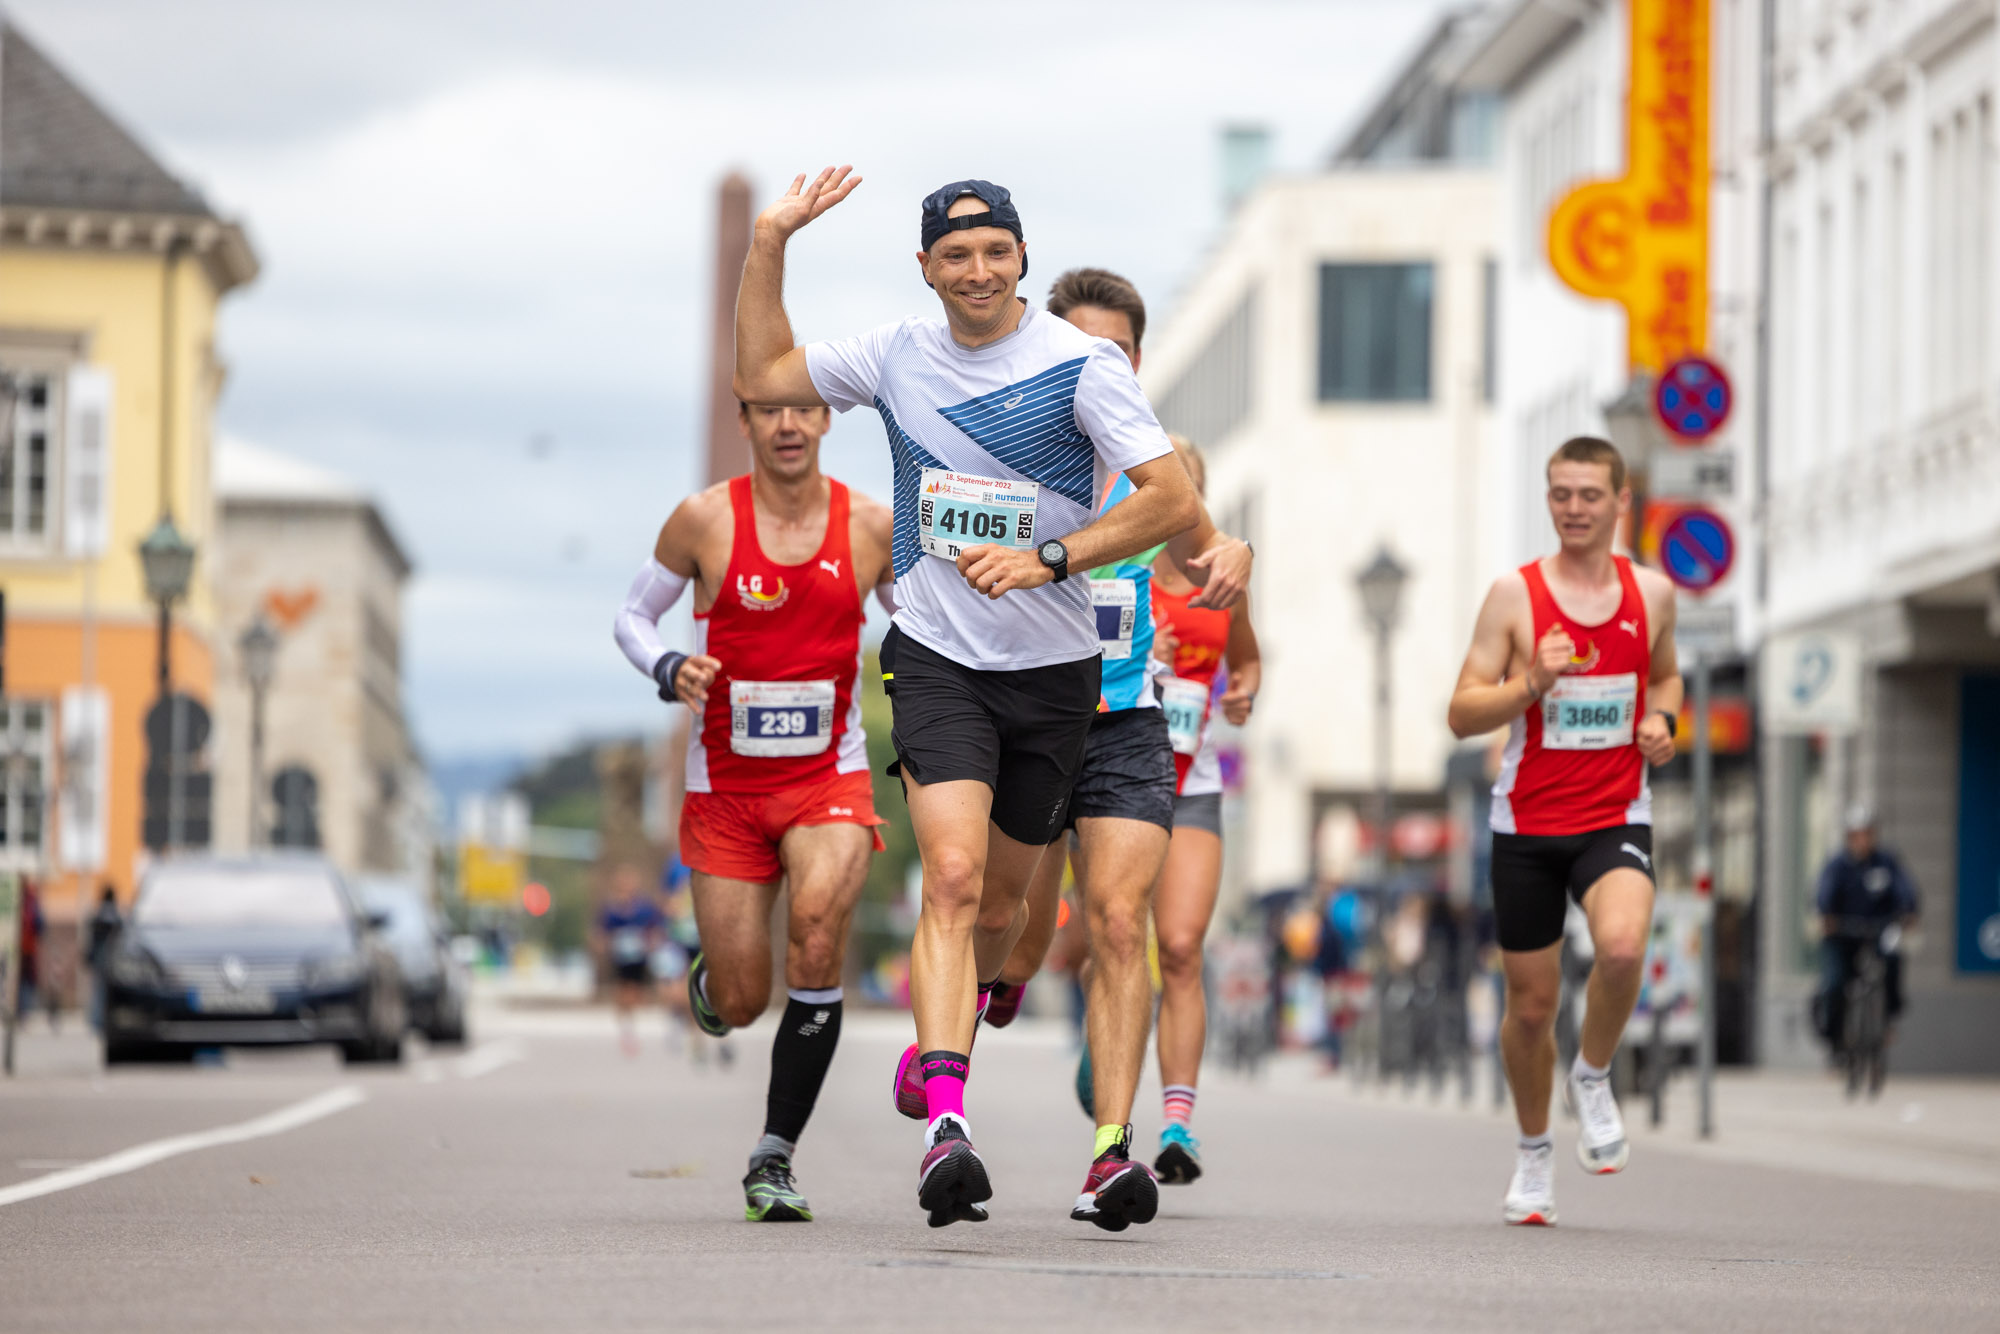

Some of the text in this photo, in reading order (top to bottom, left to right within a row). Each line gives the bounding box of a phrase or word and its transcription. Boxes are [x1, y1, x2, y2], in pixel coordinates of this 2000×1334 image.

[957, 475, 993, 487] September
[994, 481, 1012, 490] 2022
[940, 508, 1007, 538] 4105
[930, 542, 936, 551] A
[948, 545, 960, 557] Th
[761, 711, 807, 735] 239
[1169, 709, 1191, 729] 01
[1567, 706, 1619, 727] 3860
